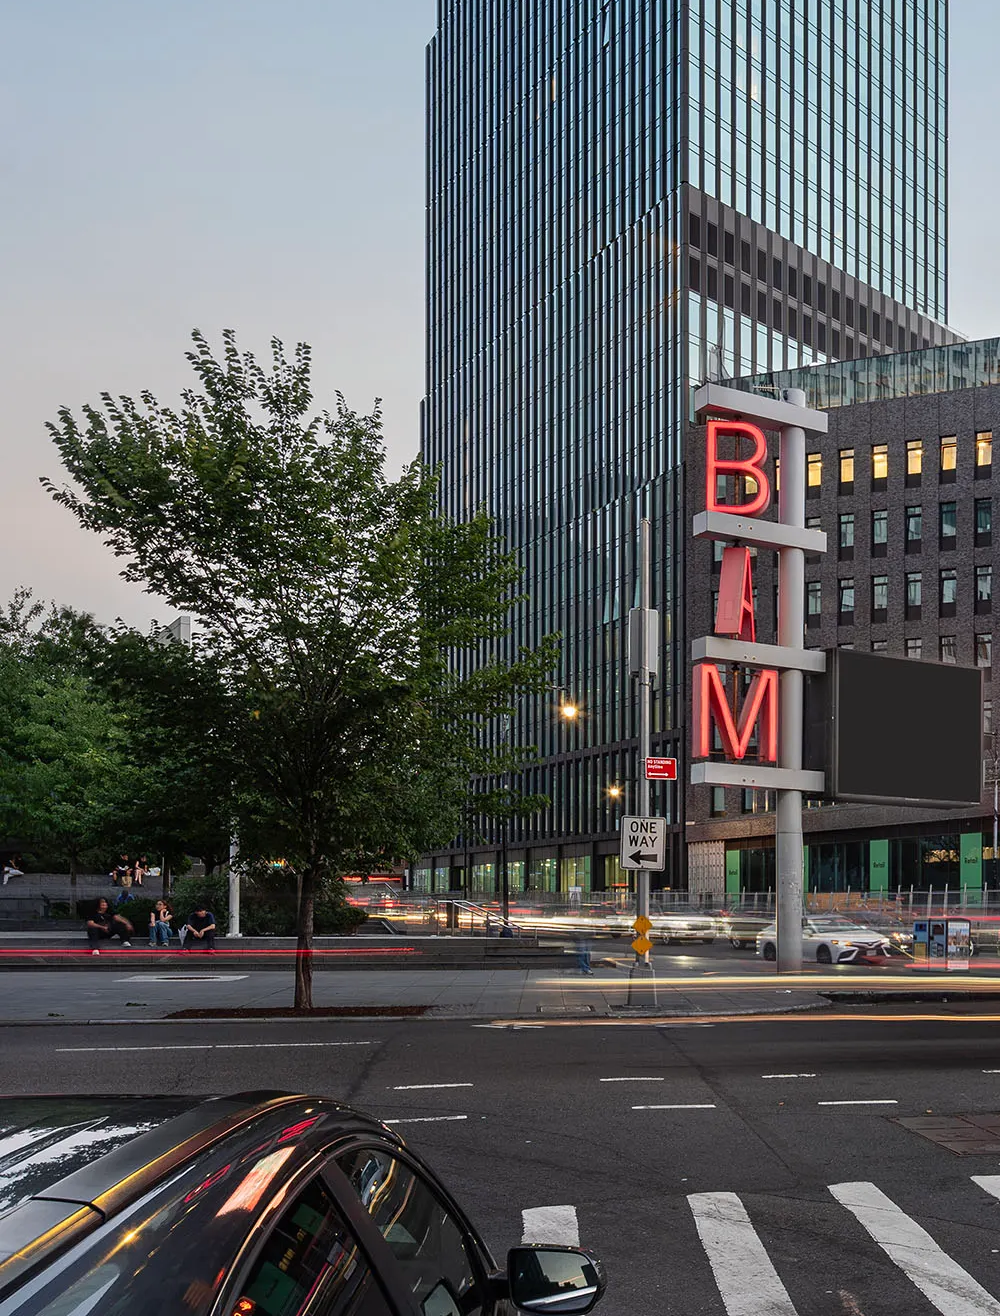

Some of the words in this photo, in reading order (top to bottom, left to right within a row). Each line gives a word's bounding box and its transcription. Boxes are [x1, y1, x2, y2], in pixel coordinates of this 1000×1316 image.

[692, 420, 779, 762] BAM
[630, 821, 657, 834] ONE
[628, 835, 658, 847] WAY
